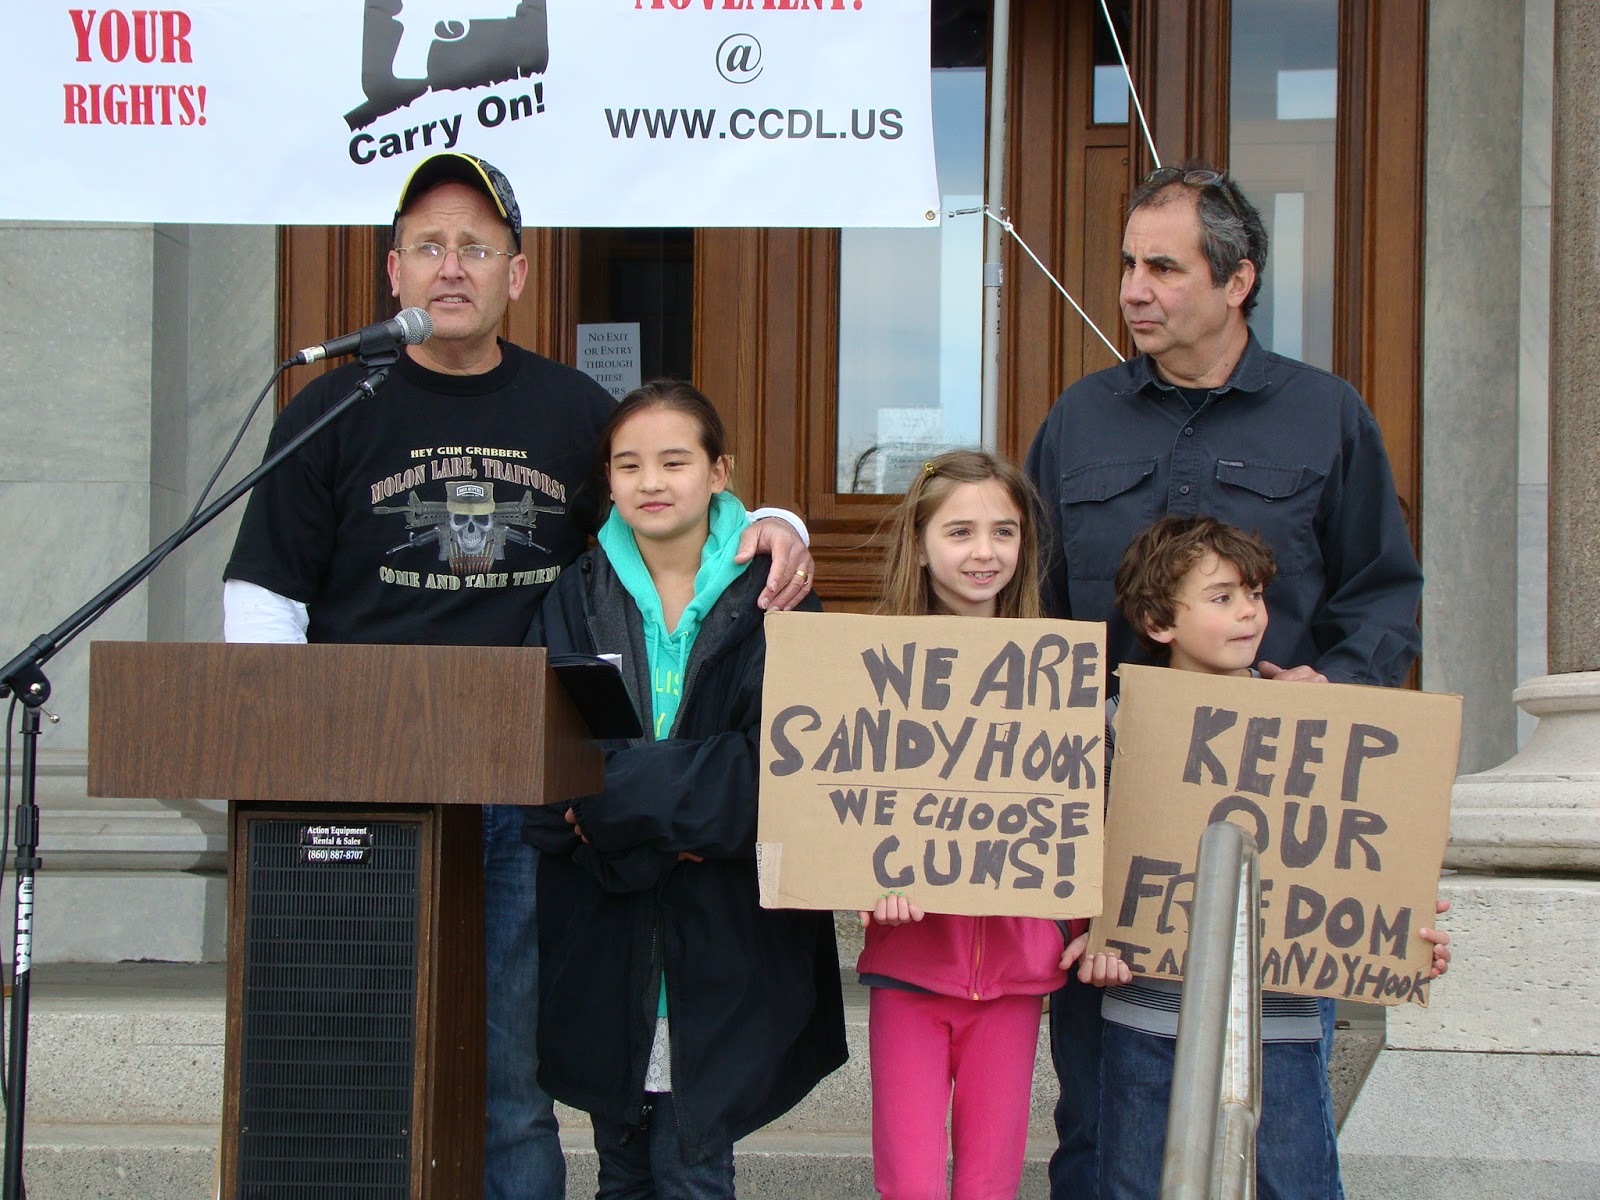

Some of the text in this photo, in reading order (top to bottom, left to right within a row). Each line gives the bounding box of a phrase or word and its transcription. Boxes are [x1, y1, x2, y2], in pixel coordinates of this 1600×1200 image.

[69, 9, 194, 64] YOUR
[715, 33, 764, 84] @
[63, 84, 207, 126] RIGHTS!
[349, 82, 546, 165] Carry On!
[604, 108, 904, 140] WWW.CCDL.US
[584, 346, 633, 355] OR ENTRY
[607, 332, 629, 341] EXIT
[585, 360, 633, 368] THROUGH
[595, 374, 624, 382] THESE
[608, 387, 626, 395] ORS
[410, 446, 528, 459] HEY GUN GRABBERS
[370, 456, 567, 505] MOLON LABE, TRAITORS!
[379, 566, 420, 588] COME
[425, 573, 461, 591] AND
[465, 572, 509, 588] TAKE
[861, 633, 1099, 711] WE ARE
[1183, 705, 1399, 803] KEEP
[828, 787, 1090, 841] WE CHOOSE
[307, 826, 367, 836] Action Equipment
[313, 836, 361, 846] Rental & Sales
[308, 849, 363, 861] (860) 887-8707
[1116, 855, 1412, 960] FRDOM
[15, 881, 33, 975] ULTRA
[1155, 947, 1188, 977] A
